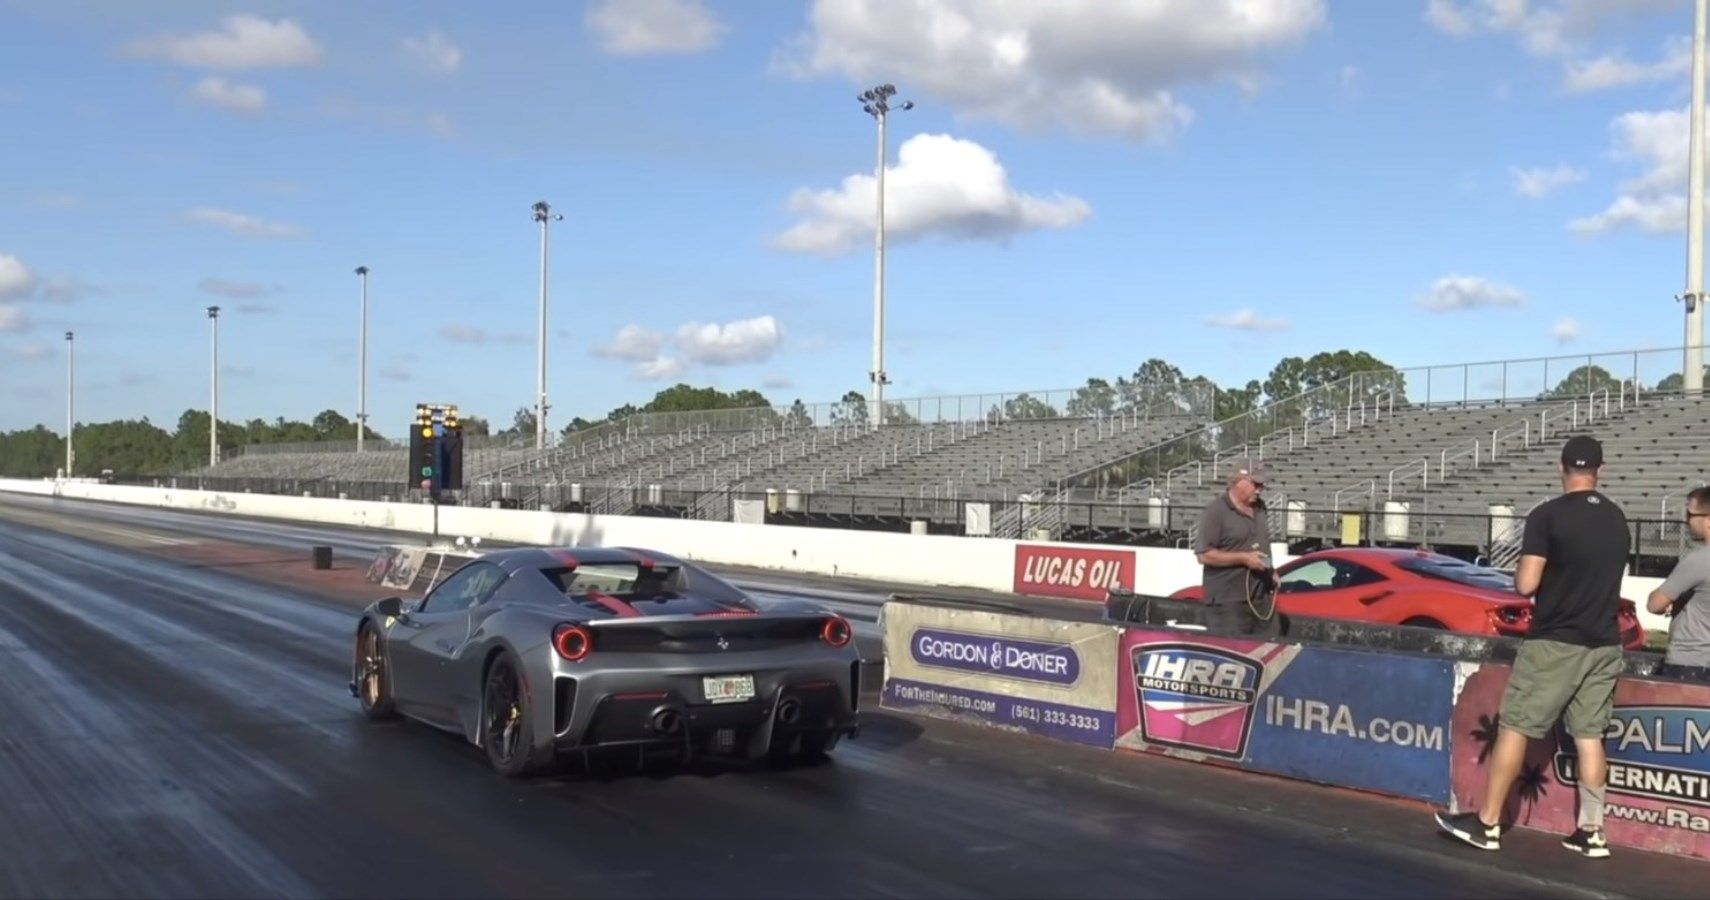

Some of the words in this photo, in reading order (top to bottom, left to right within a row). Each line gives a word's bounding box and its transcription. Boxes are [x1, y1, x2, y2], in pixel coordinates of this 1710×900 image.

[1023, 555, 1086, 587] LUCAS
[1089, 559, 1121, 589] OIL
[990, 642, 1001, 670] &
[1145, 653, 1247, 689] IHRA
[1142, 678, 1248, 701] MOTORSPORTS
[1011, 704, 1040, 723] (561)
[1044, 709, 1100, 731] 333-3333
[1265, 694, 1445, 751] IHRA.COM
